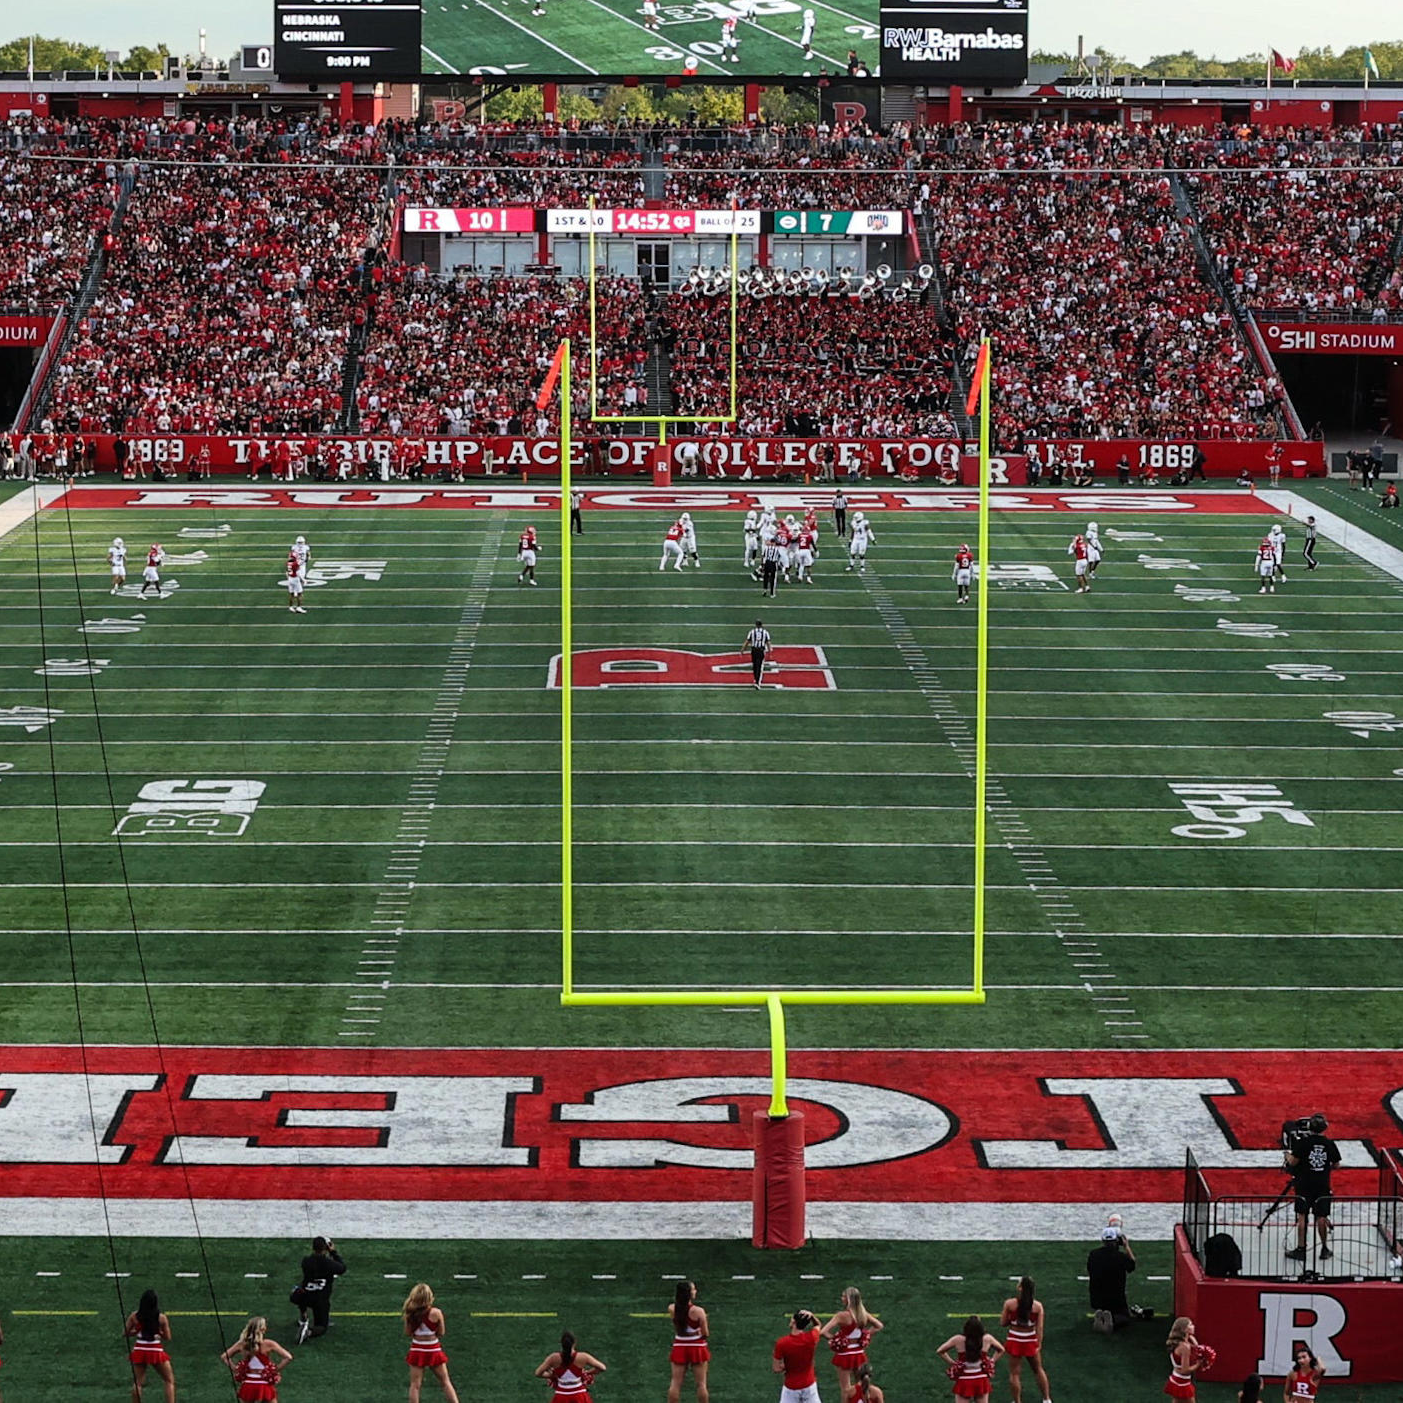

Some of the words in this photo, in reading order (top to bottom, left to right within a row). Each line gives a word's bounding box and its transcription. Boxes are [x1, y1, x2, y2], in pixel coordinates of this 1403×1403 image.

[282, 15, 340, 26] NEBRASKA
[282, 31, 345, 42] CINCINNATI
[884, 27, 1024, 49] RWJBarnabas
[257, 47, 270, 68] 0
[326, 56, 352, 67] 9:00
[353, 56, 371, 67] PM
[902, 48, 961, 61] HEALTH
[1066, 86, 1098, 99] Pizza
[1099, 85, 1121, 99] Hut
[418, 211, 440, 229] R
[469, 212, 493, 229] 10
[555, 217, 574, 225] 1ST
[578, 217, 587, 225] &
[617, 214, 670, 229] 14:52
[741, 217, 755, 226] 25
[820, 214, 832, 231] 7
[1279, 331, 1315, 348] SHI
[1320, 334, 1395, 348] STADIUM
[608, 441, 654, 465] OF
[1139, 444, 1195, 468] 1869
[657, 461, 668, 471] R
[1257, 1292, 1351, 1377] R
[1296, 1381, 1310, 1395] R
